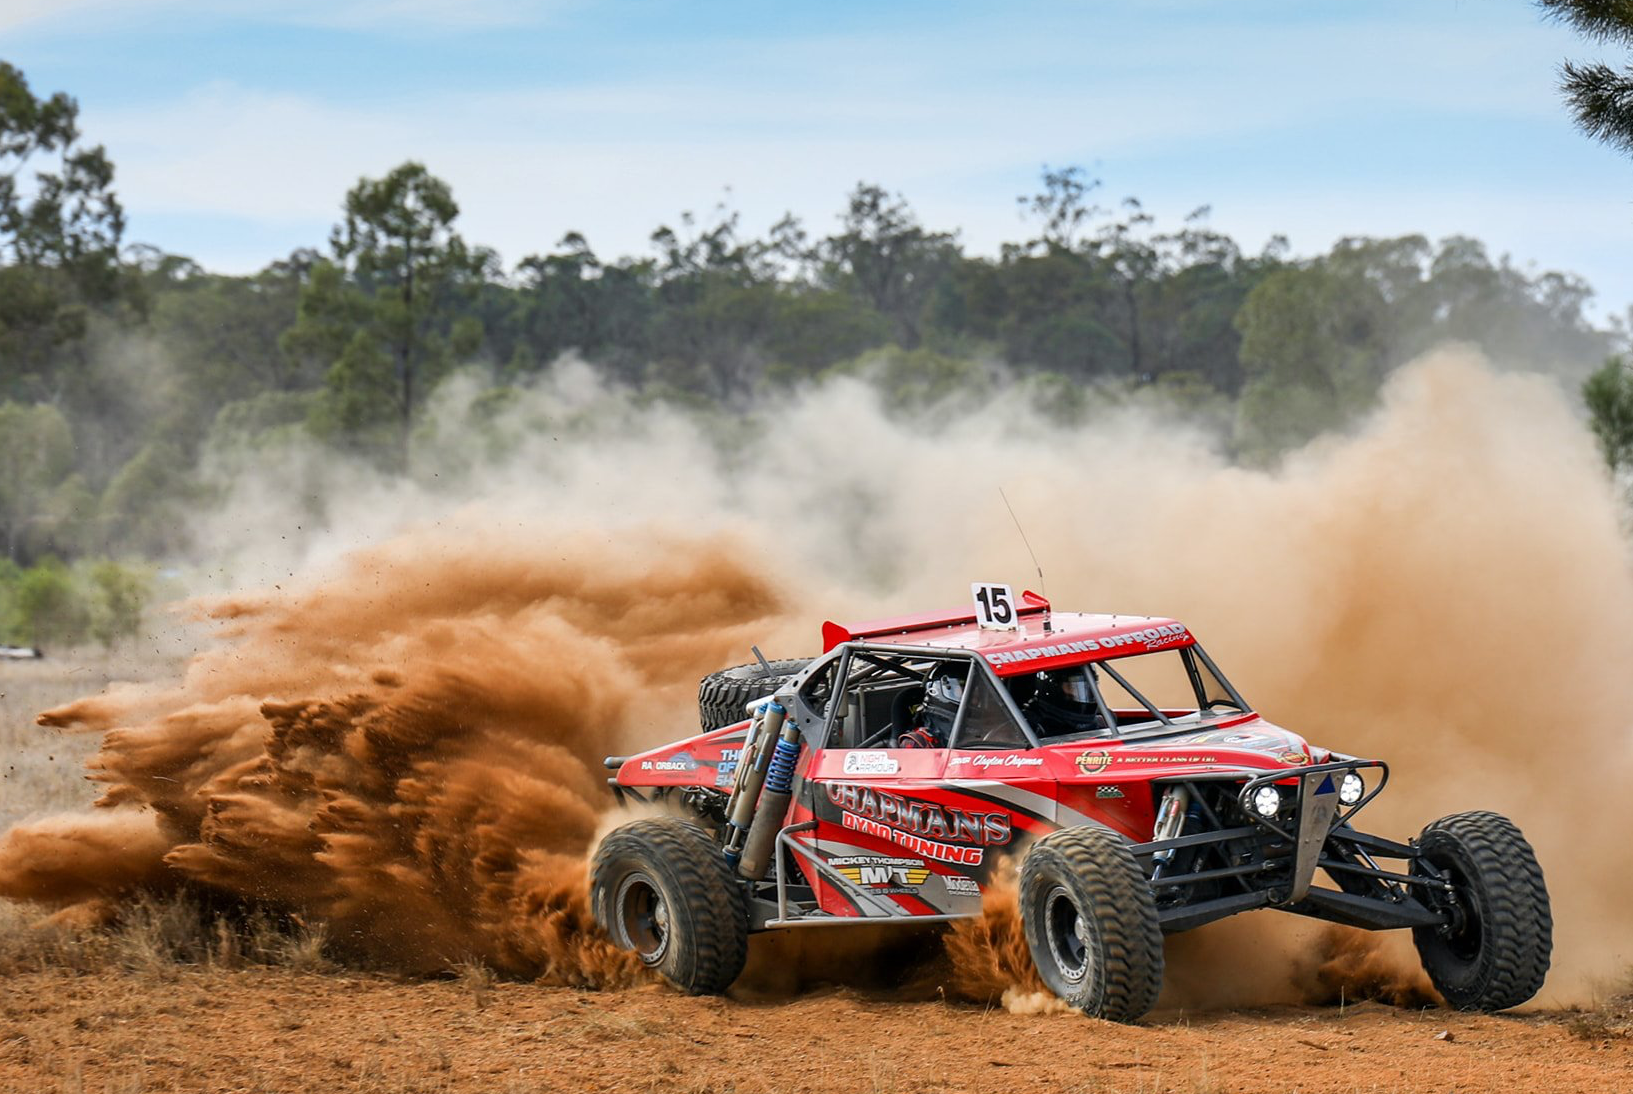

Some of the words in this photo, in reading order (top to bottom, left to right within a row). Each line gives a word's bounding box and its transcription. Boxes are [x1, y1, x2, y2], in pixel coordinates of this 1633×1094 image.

[976, 587, 1011, 624] 15
[985, 638, 1100, 665] CHAPMANS
[1100, 623, 1186, 649] OFFROAD
[1144, 633, 1188, 650] Racing
[1074, 756, 1113, 765] PENRITE
[825, 782, 1012, 845] CHAPMANS
[842, 811, 892, 841] DYNO
[893, 830, 983, 866] TUNING
[828, 857, 871, 866] MICKEY
[871, 857, 925, 866] THOMPSON
